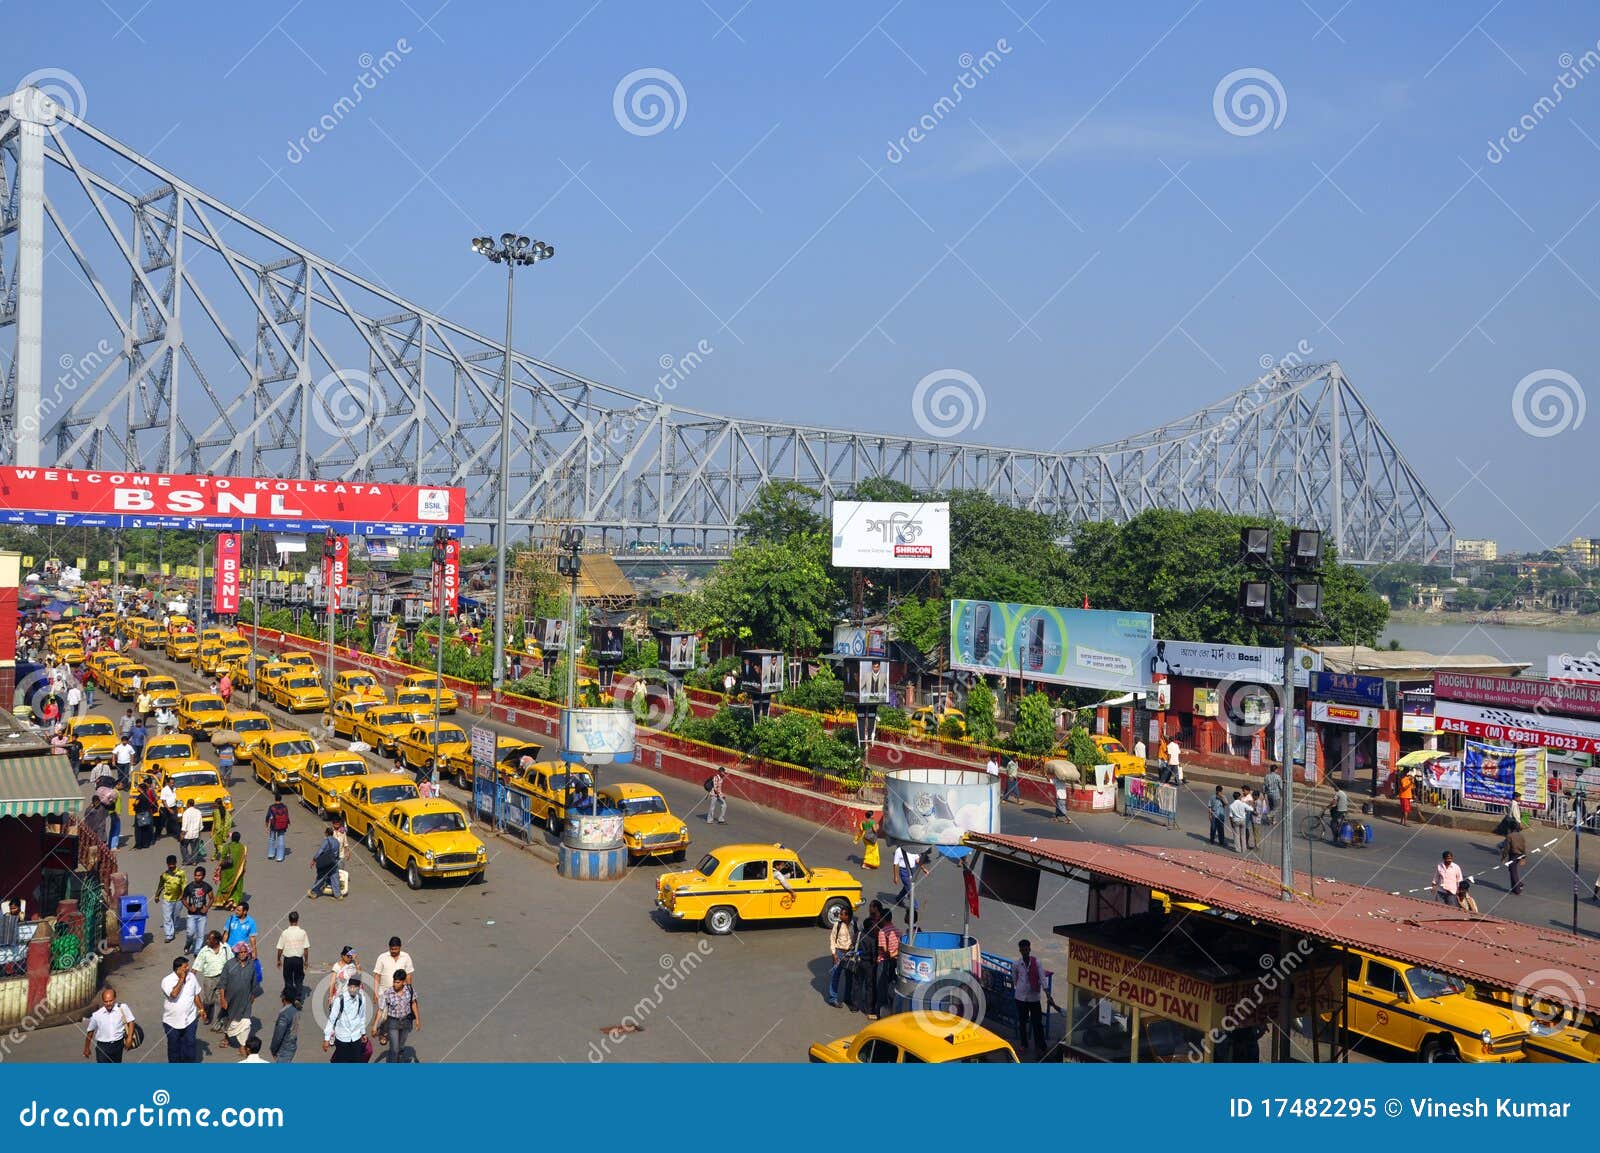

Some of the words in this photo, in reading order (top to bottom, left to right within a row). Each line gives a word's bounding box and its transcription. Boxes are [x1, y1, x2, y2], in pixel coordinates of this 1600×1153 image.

[15, 469, 171, 487] WELCOME
[195, 478, 231, 488] TO
[255, 481, 382, 495] KOLKATA
[114, 488, 303, 516] BSNL
[896, 546, 931, 554] SHRICON
[223, 559, 236, 609] BSNL
[1238, 653, 1262, 662] Boss!
[1330, 674, 1359, 689] TAJ
[1438, 674, 1475, 689] HOOGHLY
[1476, 678, 1495, 692] NADI
[1496, 680, 1537, 696] JALAPATH
[1442, 718, 1470, 733] Ask
[1475, 726, 1480, 735] :
[1485, 725, 1504, 741] (M)
[1544, 734, 1577, 750] 21023
[1121, 958, 1177, 991] ASSISTANCE
[1179, 976, 1212, 1001] BOOTH
[1078, 966, 1158, 1007] PRE-PAID
[1160, 992, 1200, 1023] TAXI
